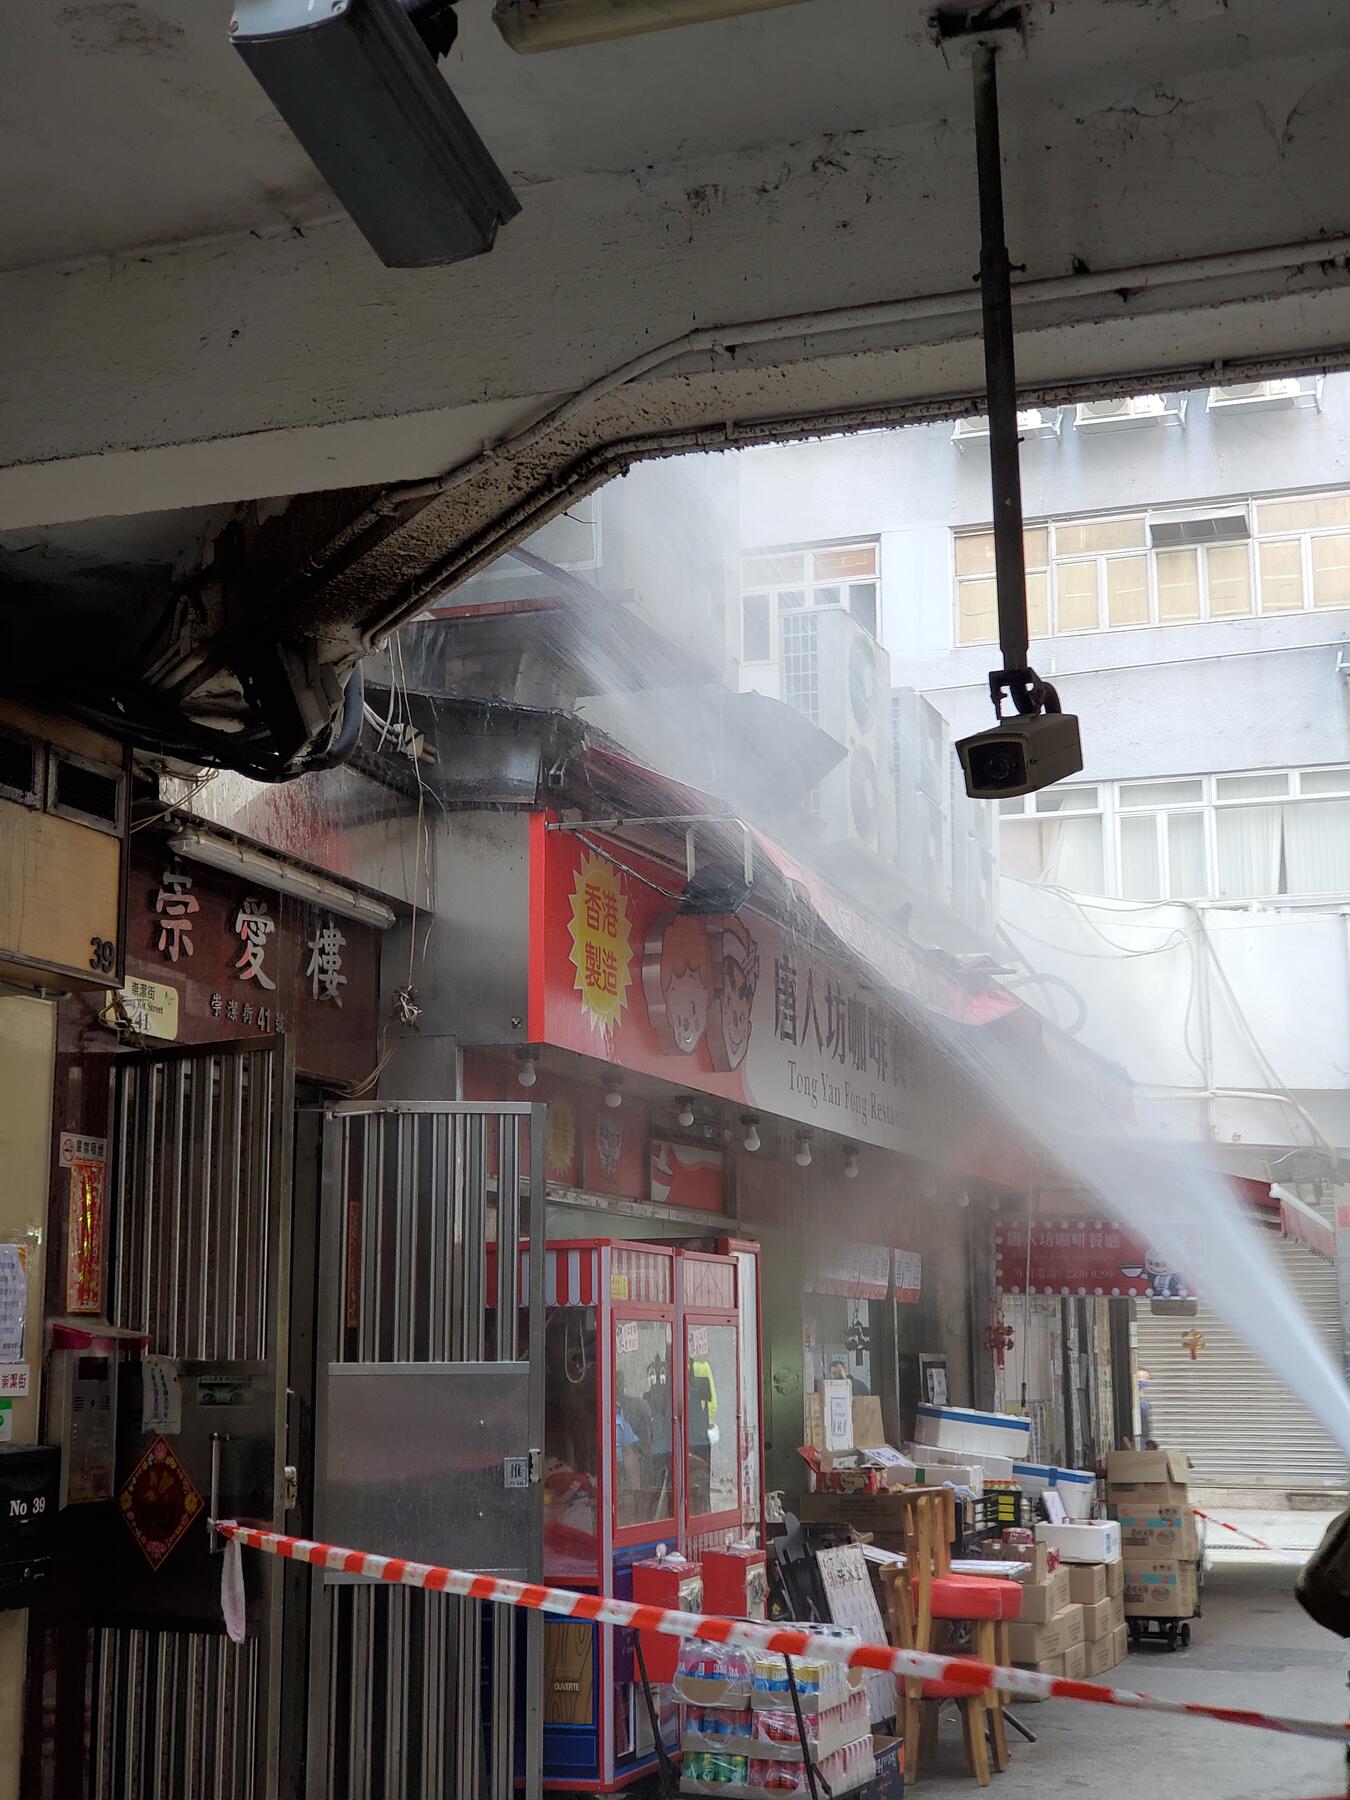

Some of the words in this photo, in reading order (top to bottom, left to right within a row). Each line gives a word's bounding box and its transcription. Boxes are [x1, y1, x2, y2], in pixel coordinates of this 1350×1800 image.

[585, 883, 618, 938] 香港
[155, 855, 348, 1008] 崇愛樓
[89, 936, 115, 973] 39
[585, 941, 618, 996] 製造
[134, 1012, 149, 1031] 41
[148, 1003, 164, 1014] Street
[821, 1072, 841, 1106] Yan
[844, 1081, 868, 1126] Fong
[9, 1500, 28, 1516] No
[32, 1496, 46, 1514] 39
[553, 1682, 580, 1692] OUVERTE
